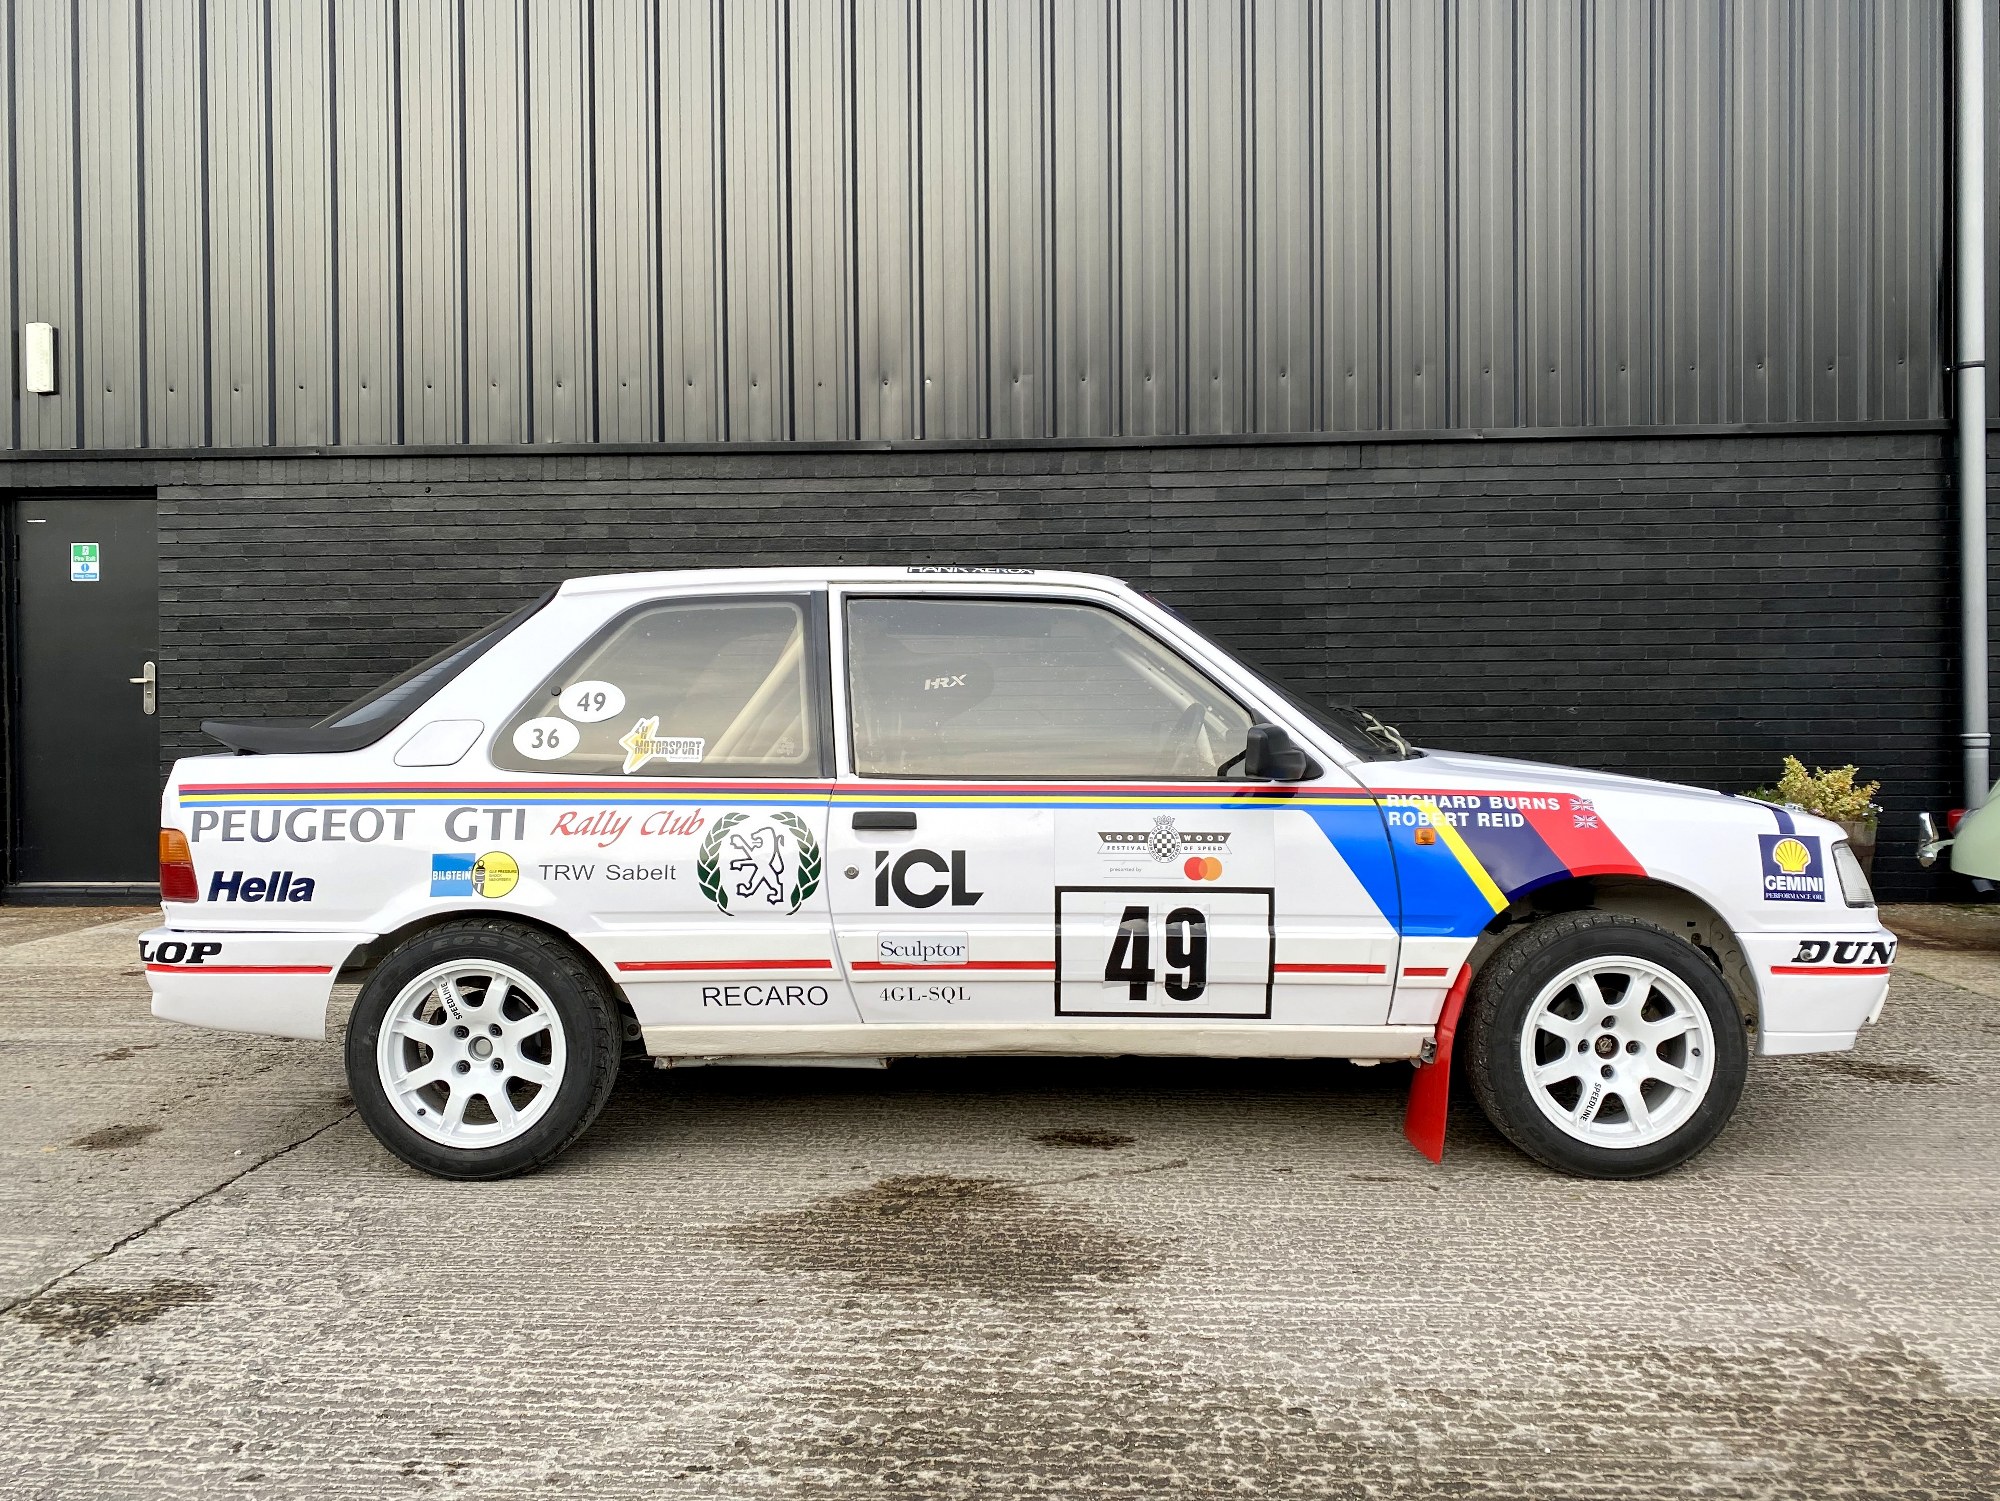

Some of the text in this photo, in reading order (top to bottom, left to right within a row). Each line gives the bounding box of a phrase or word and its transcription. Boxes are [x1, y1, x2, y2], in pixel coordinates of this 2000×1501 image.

[924, 674, 967, 691] HRX
[577, 692, 607, 712] 49
[531, 728, 560, 749] 36
[634, 739, 702, 755] MOTORSPORT
[1386, 794, 1561, 811] RICHARD BURNS
[190, 806, 526, 842] PEUGEOT GTI
[550, 808, 705, 848] Rally Club
[1388, 811, 1525, 828] ROBERT REID
[432, 870, 472, 881] BILSTEIN
[538, 864, 677, 881] TRW Sabelt
[874, 849, 985, 909] ICL
[207, 870, 316, 902] Hella
[1764, 875, 1824, 892] GEMINI
[1765, 892, 1812, 900] PERFORMANCE
[139, 940, 223, 964] LOP
[431, 934, 542, 972] ECSTA
[880, 940, 966, 963] Sculptor
[1104, 905, 1208, 1002] 49
[1791, 940, 1897, 965] DUN
[440, 980, 463, 1020] SPEEDLINE
[702, 986, 829, 1007] RECARO
[879, 985, 972, 1005] 4GL-SQL
[1579, 1082, 1602, 1122] SPEEDLINE
